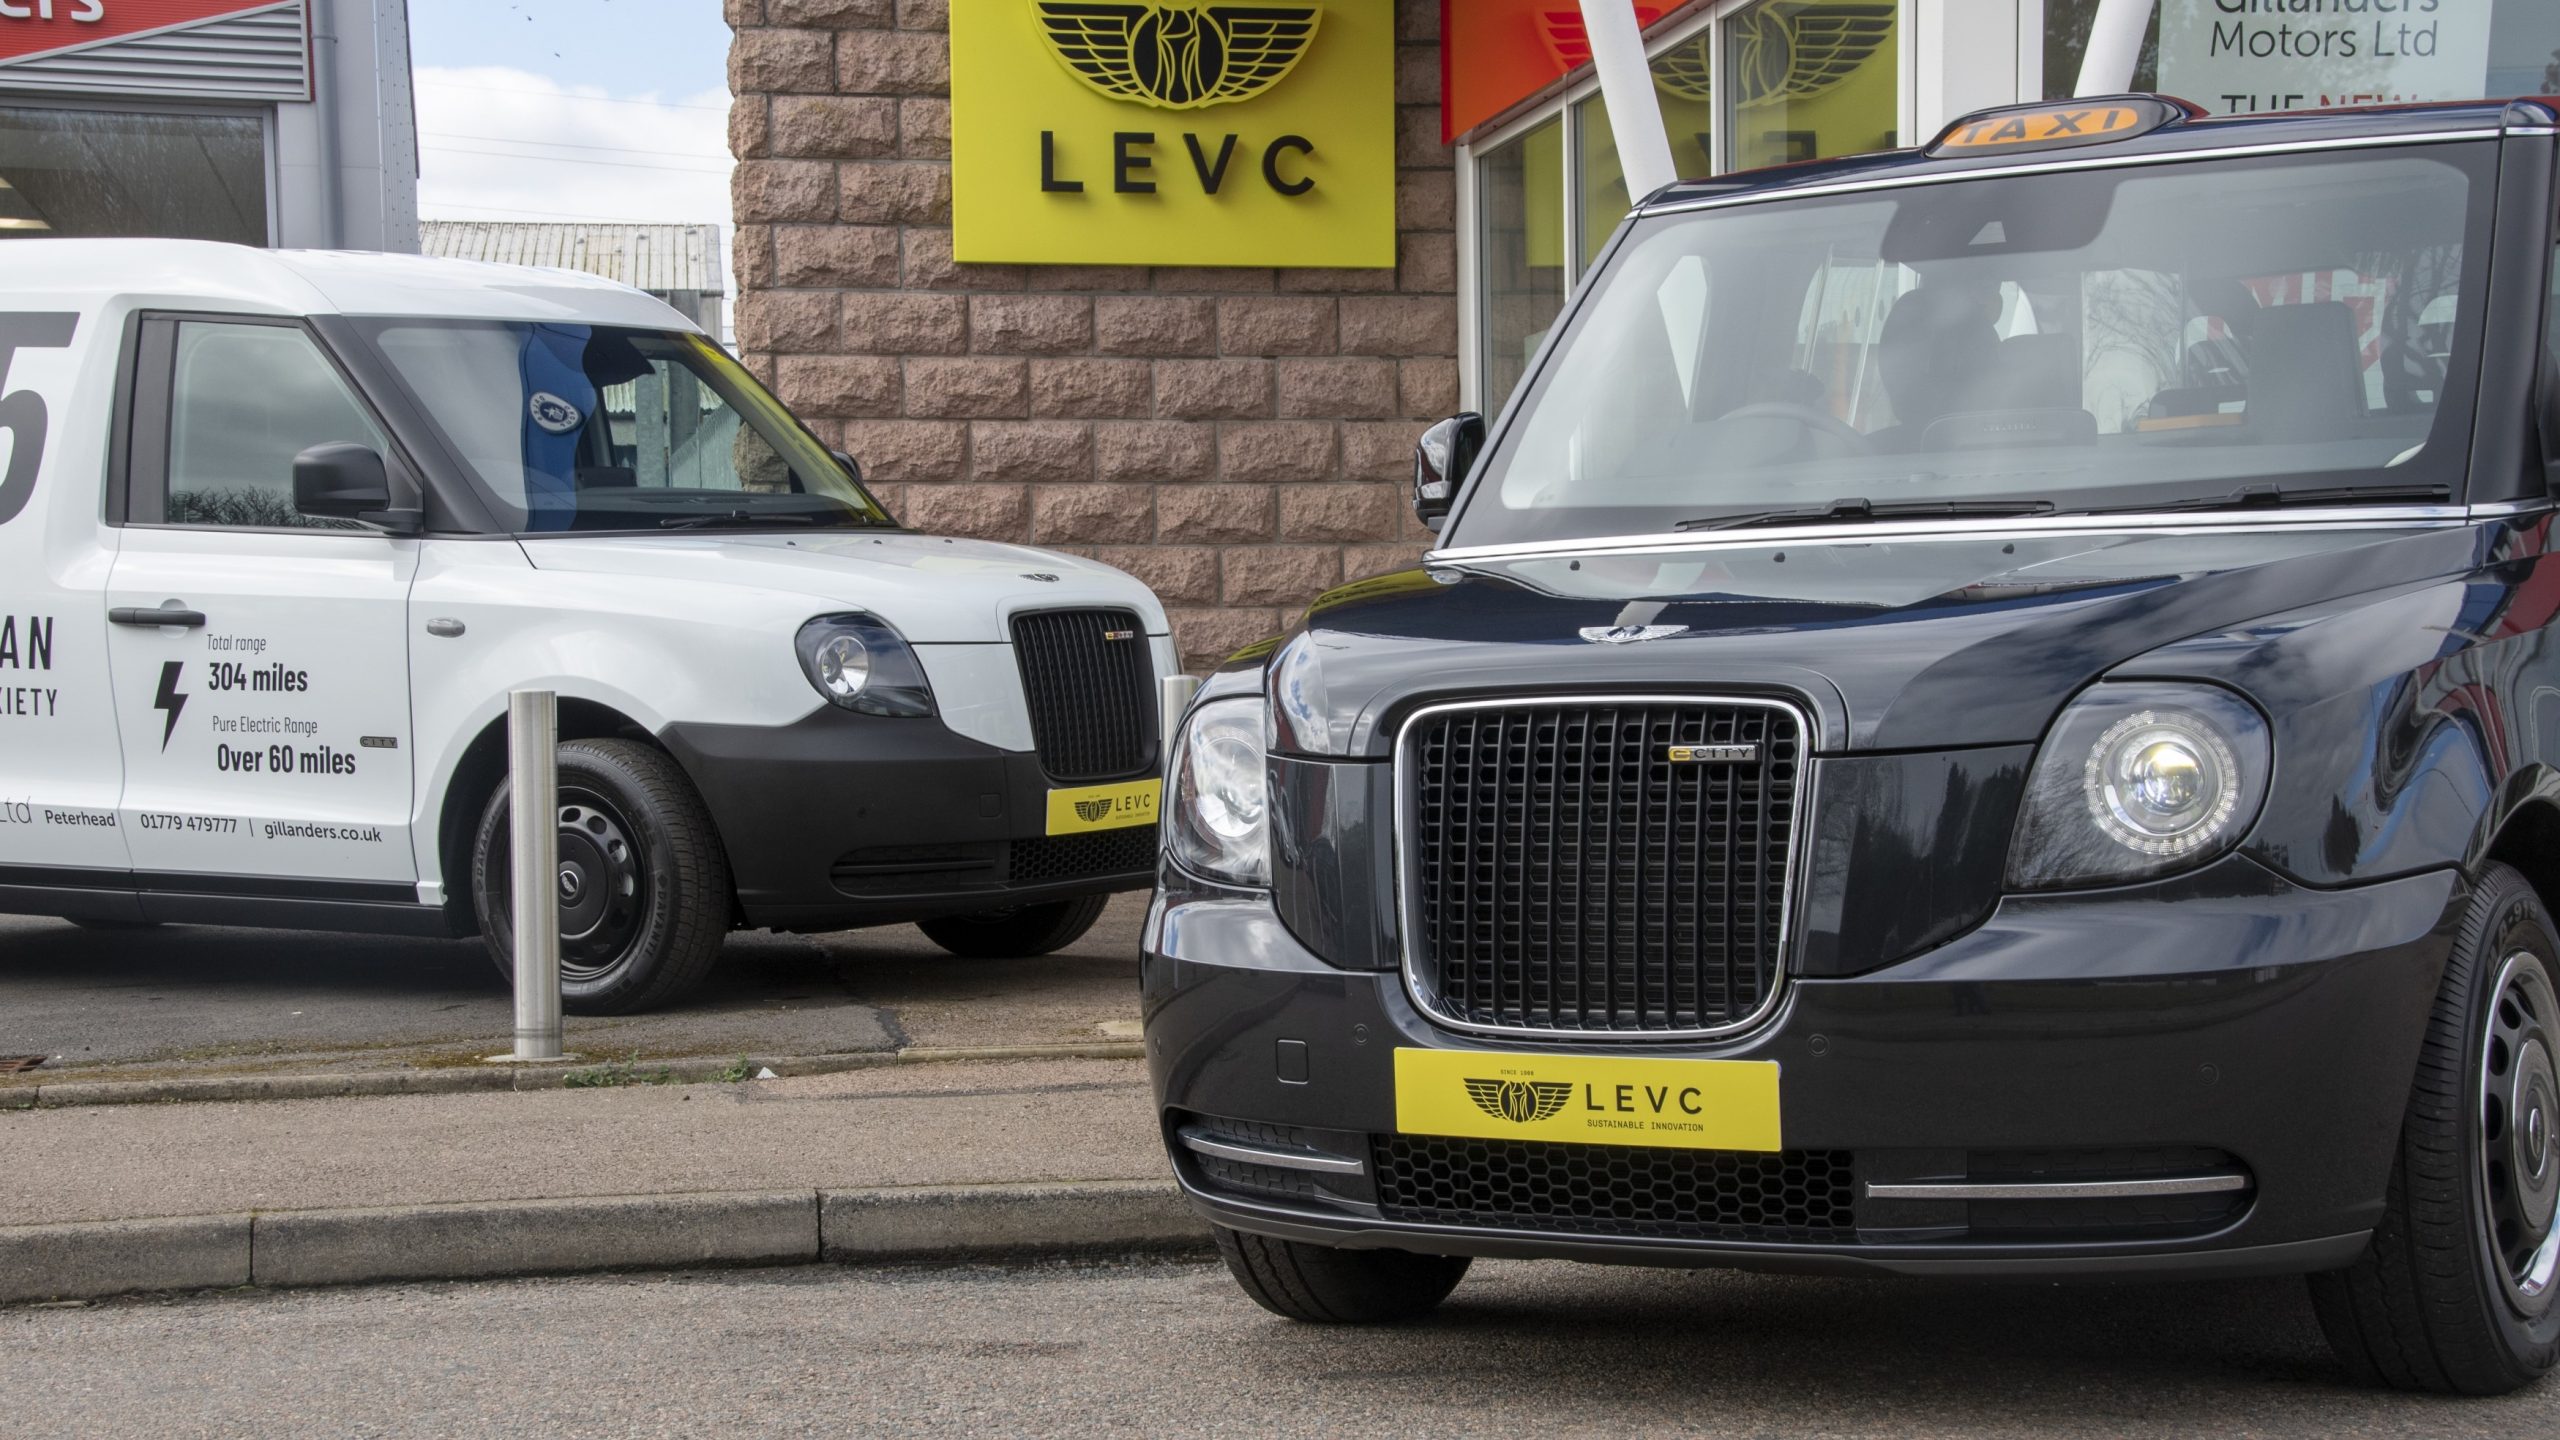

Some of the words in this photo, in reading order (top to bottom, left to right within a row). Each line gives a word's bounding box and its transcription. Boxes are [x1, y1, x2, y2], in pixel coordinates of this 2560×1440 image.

[2210, 20, 2357, 57] Motors
[2374, 19, 2438, 57] Ltd
[1961, 109, 2121, 144] TAXI
[1040, 130, 1316, 197] LEVC
[207, 634, 233, 651] Total
[235, 637, 267, 655] range
[208, 662, 247, 691] 304
[252, 662, 308, 692] miles
[0, 686, 58, 716] IETY
[212, 715, 237, 732] Pure
[240, 716, 281, 733] Electric
[284, 717, 318, 738] Range
[217, 743, 263, 772] Over
[269, 744, 294, 773] 60
[300, 744, 356, 775] miles
[1115, 793, 1151, 812] LEVC
[45, 809, 116, 827] Peterhead
[140, 813, 183, 831] 01779
[187, 816, 237, 834] 479777
[264, 820, 383, 843] gillanders.co.uk
[1585, 1083, 1702, 1115] LEVC
[1587, 1118, 1645, 1130] SUSTAINABLE
[1651, 1121, 1704, 1132] INNOVATION
